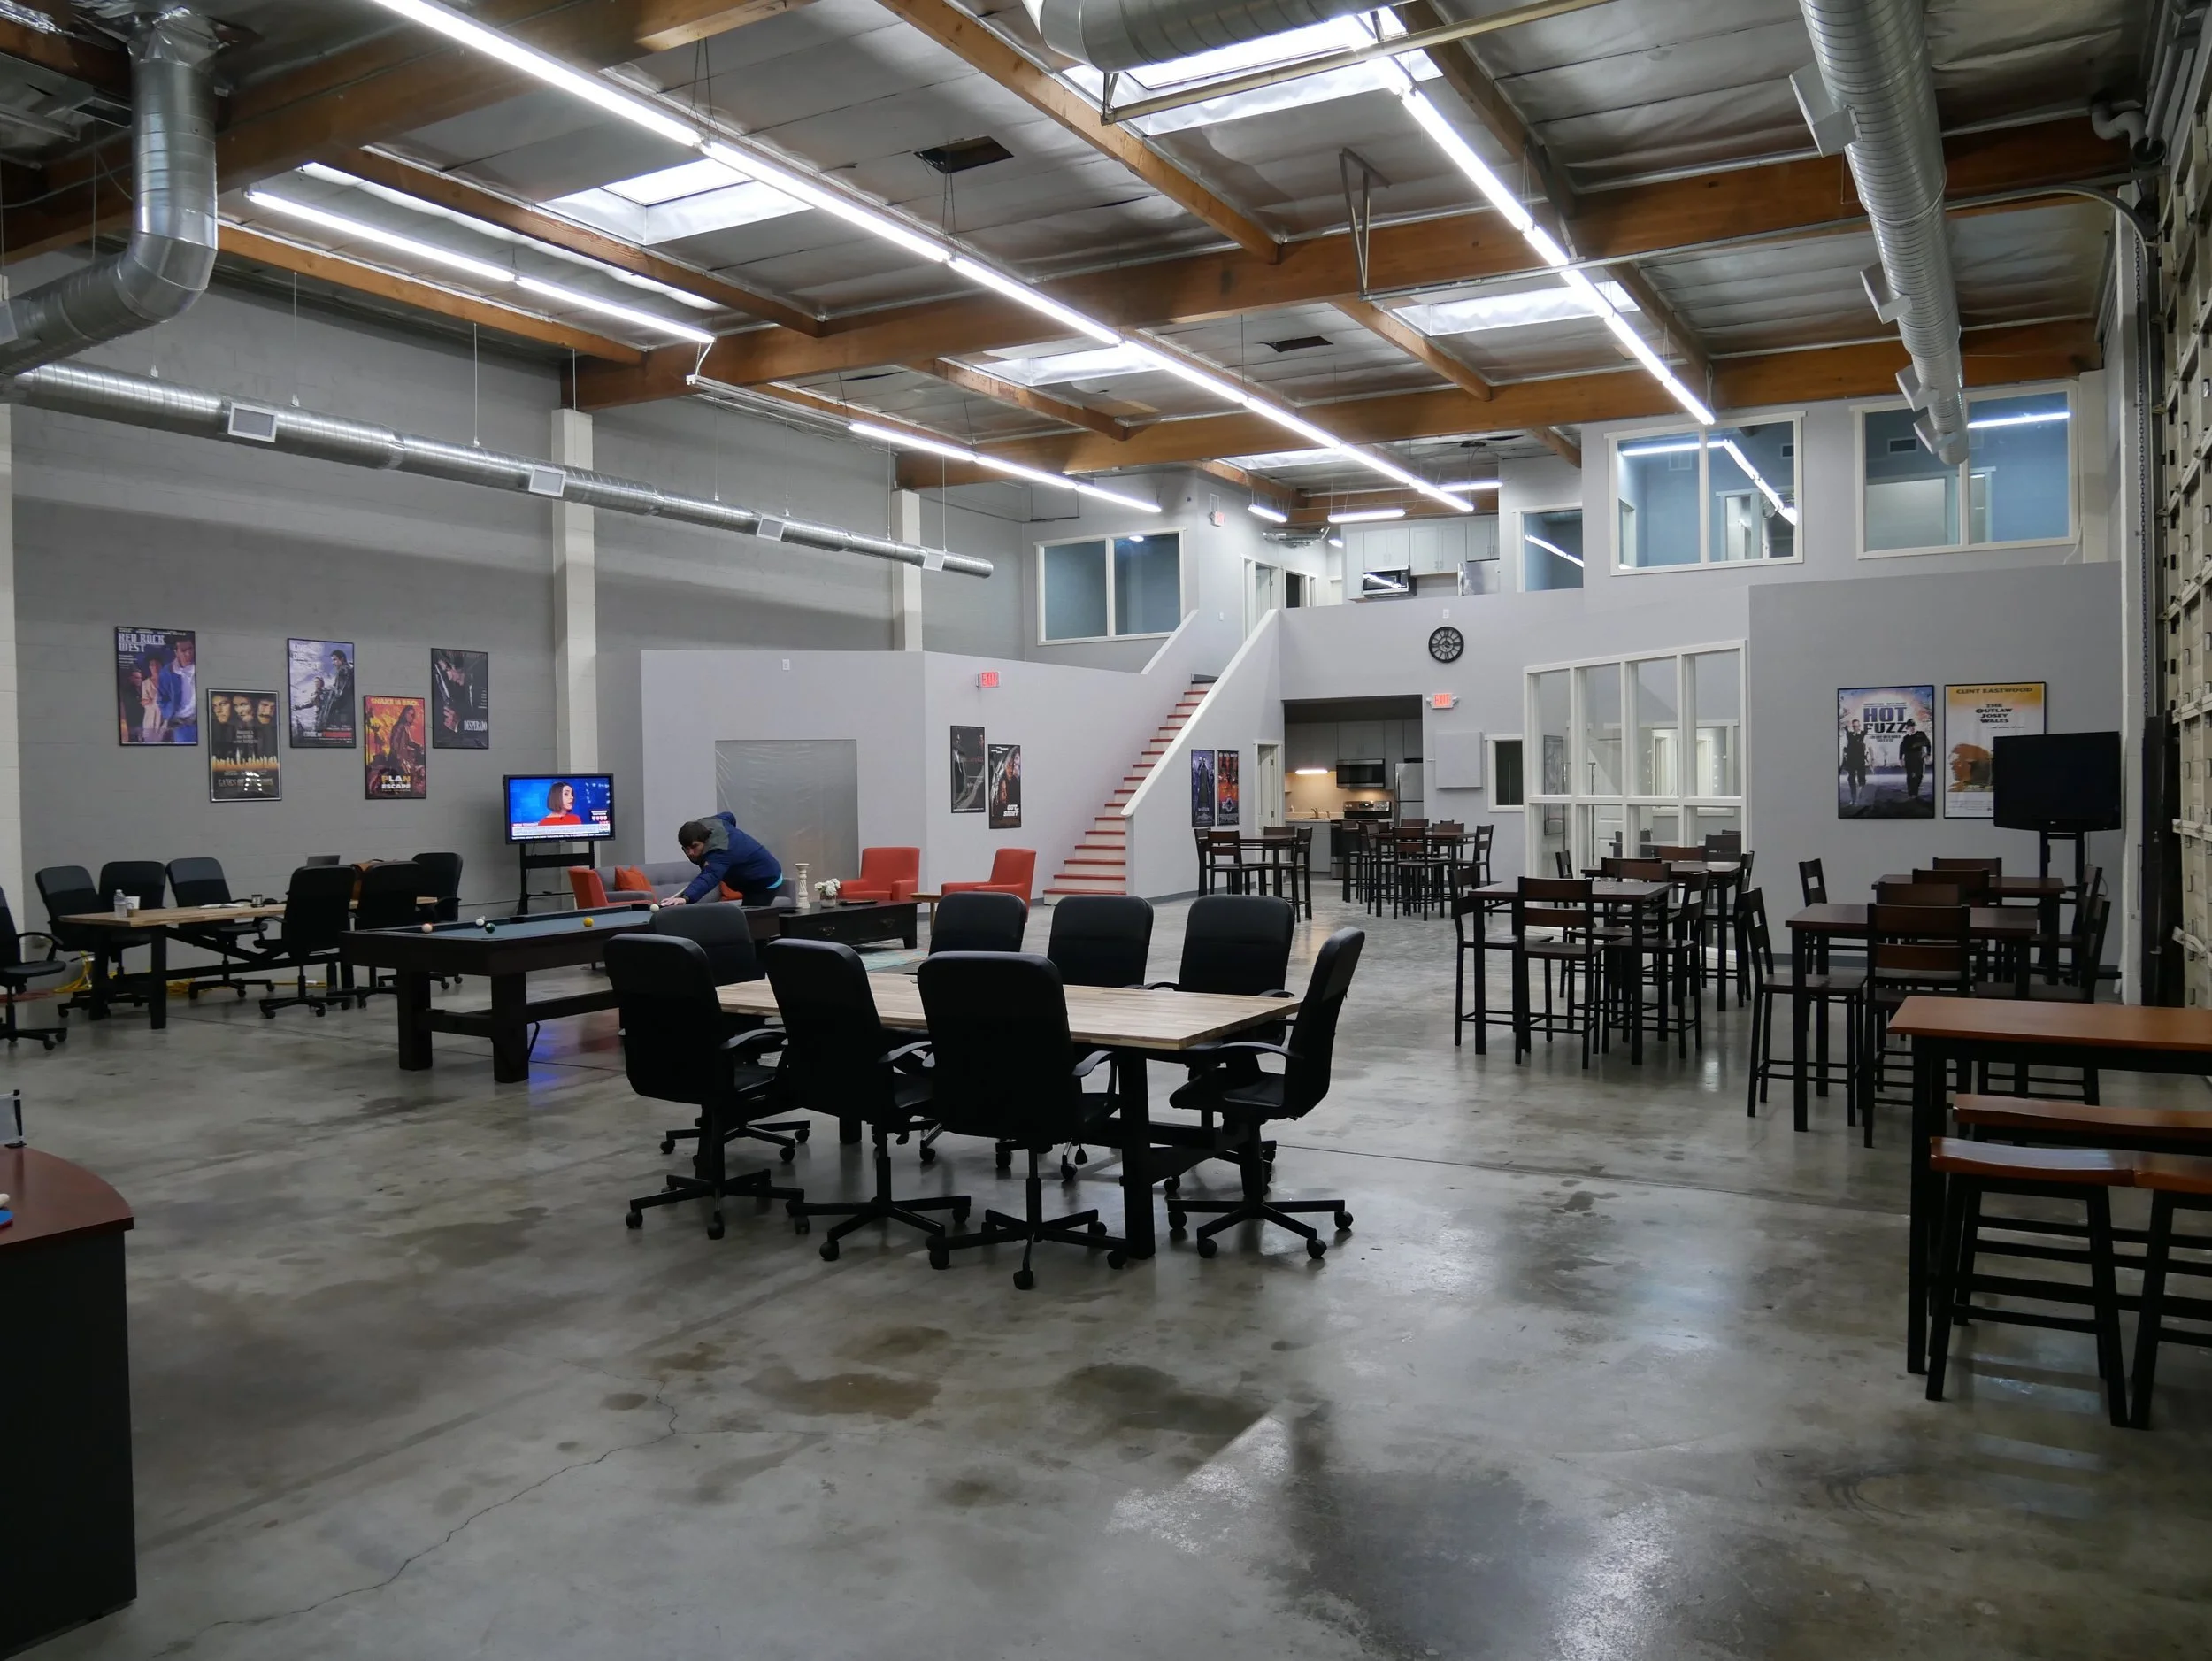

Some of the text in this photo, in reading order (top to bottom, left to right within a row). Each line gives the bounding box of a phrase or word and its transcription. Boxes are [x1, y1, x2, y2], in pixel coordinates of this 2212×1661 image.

[118, 633, 165, 645] RED ROCK
[118, 642, 144, 652] WEST
[1863, 707, 1908, 722] HOT
[464, 720, 488, 731] DESPERADO
[1863, 722, 1907, 733] FUZZ
